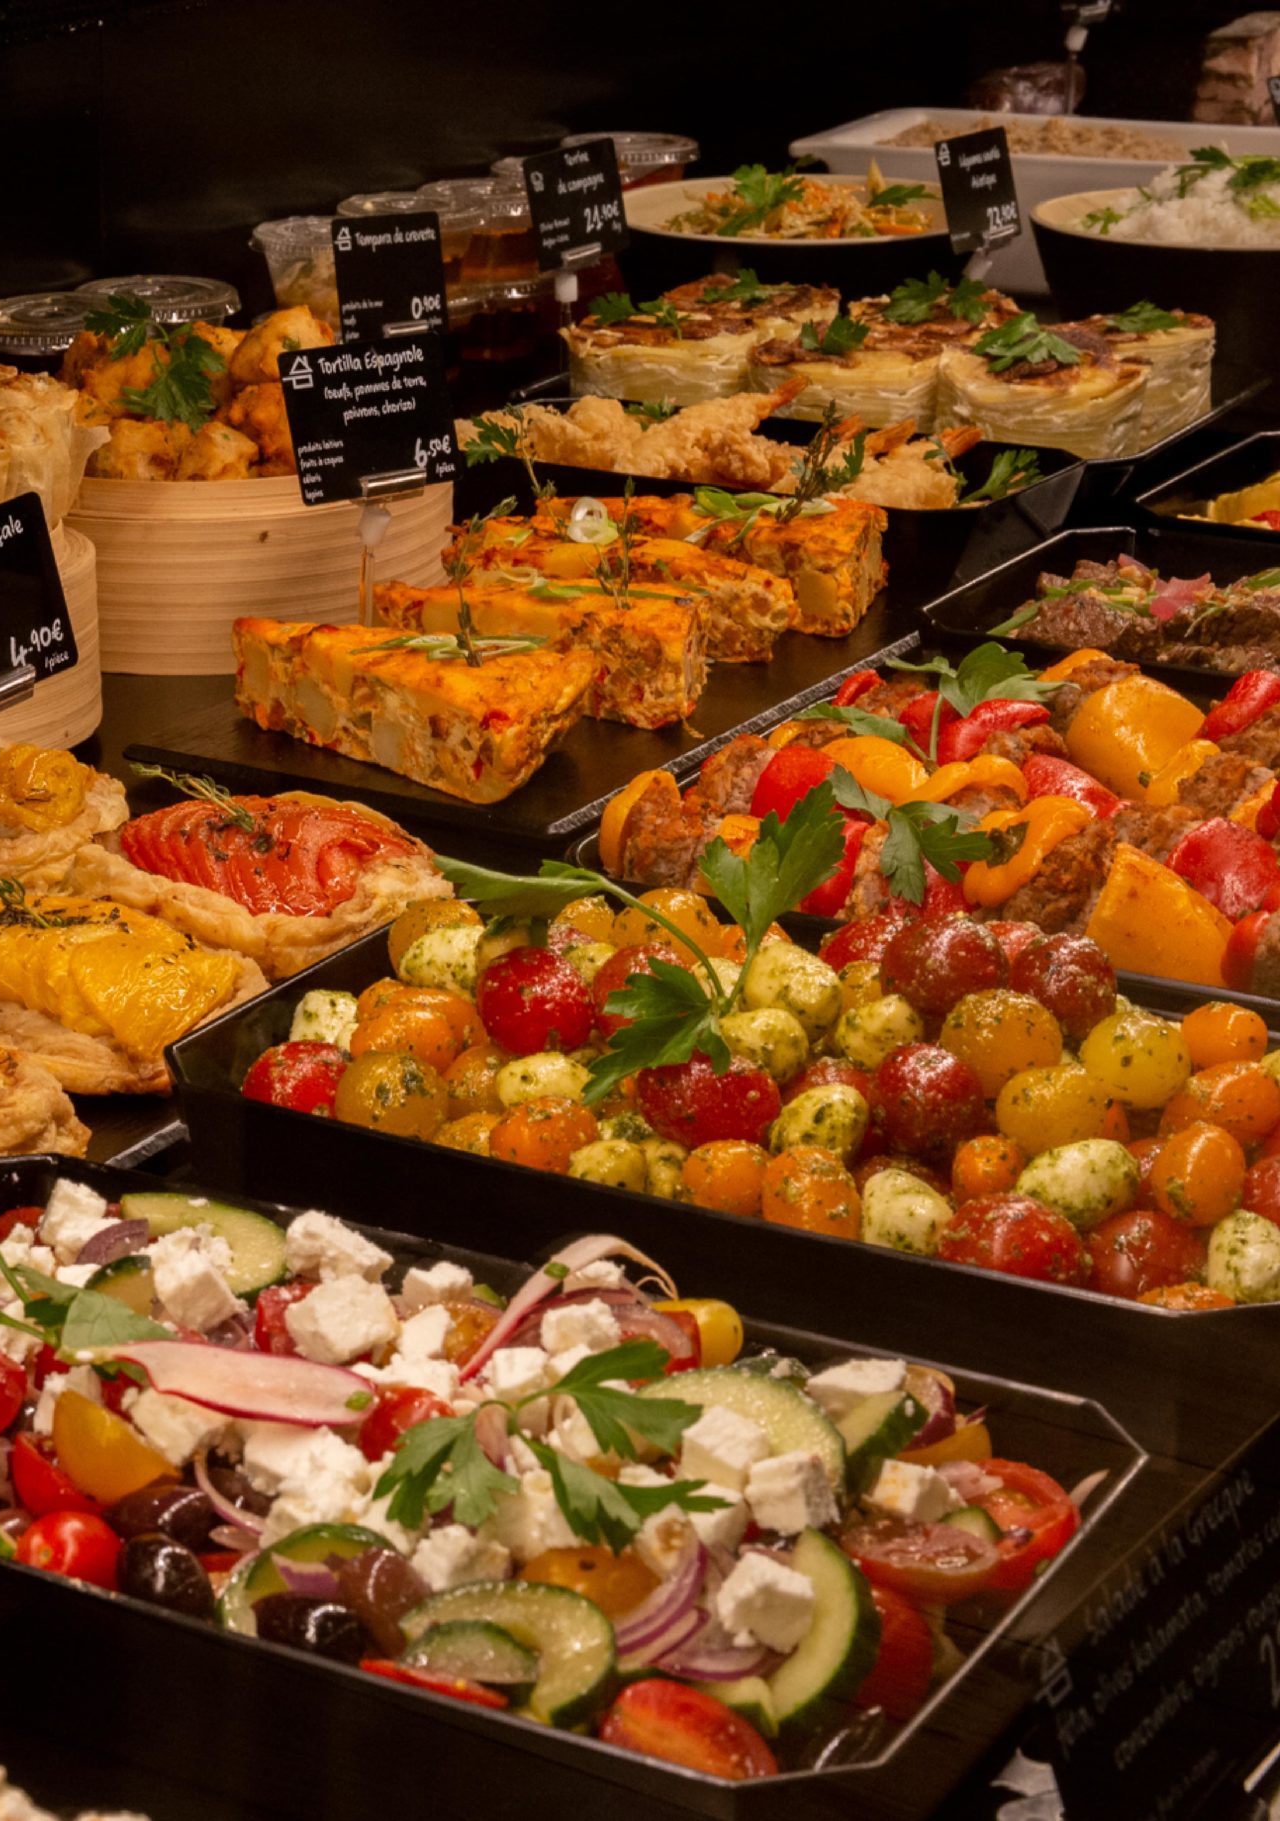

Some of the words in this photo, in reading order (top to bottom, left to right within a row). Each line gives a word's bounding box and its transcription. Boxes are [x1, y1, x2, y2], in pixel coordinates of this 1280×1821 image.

[318, 355, 362, 375] Tortilla
[364, 345, 424, 376] Espagnole
[354, 381, 390, 402] pommes
[392, 375, 402, 389] de
[414, 435, 452, 468] 6.50€
[9, 618, 63, 667] 4.90€
[44, 650, 69, 672] /pièce
